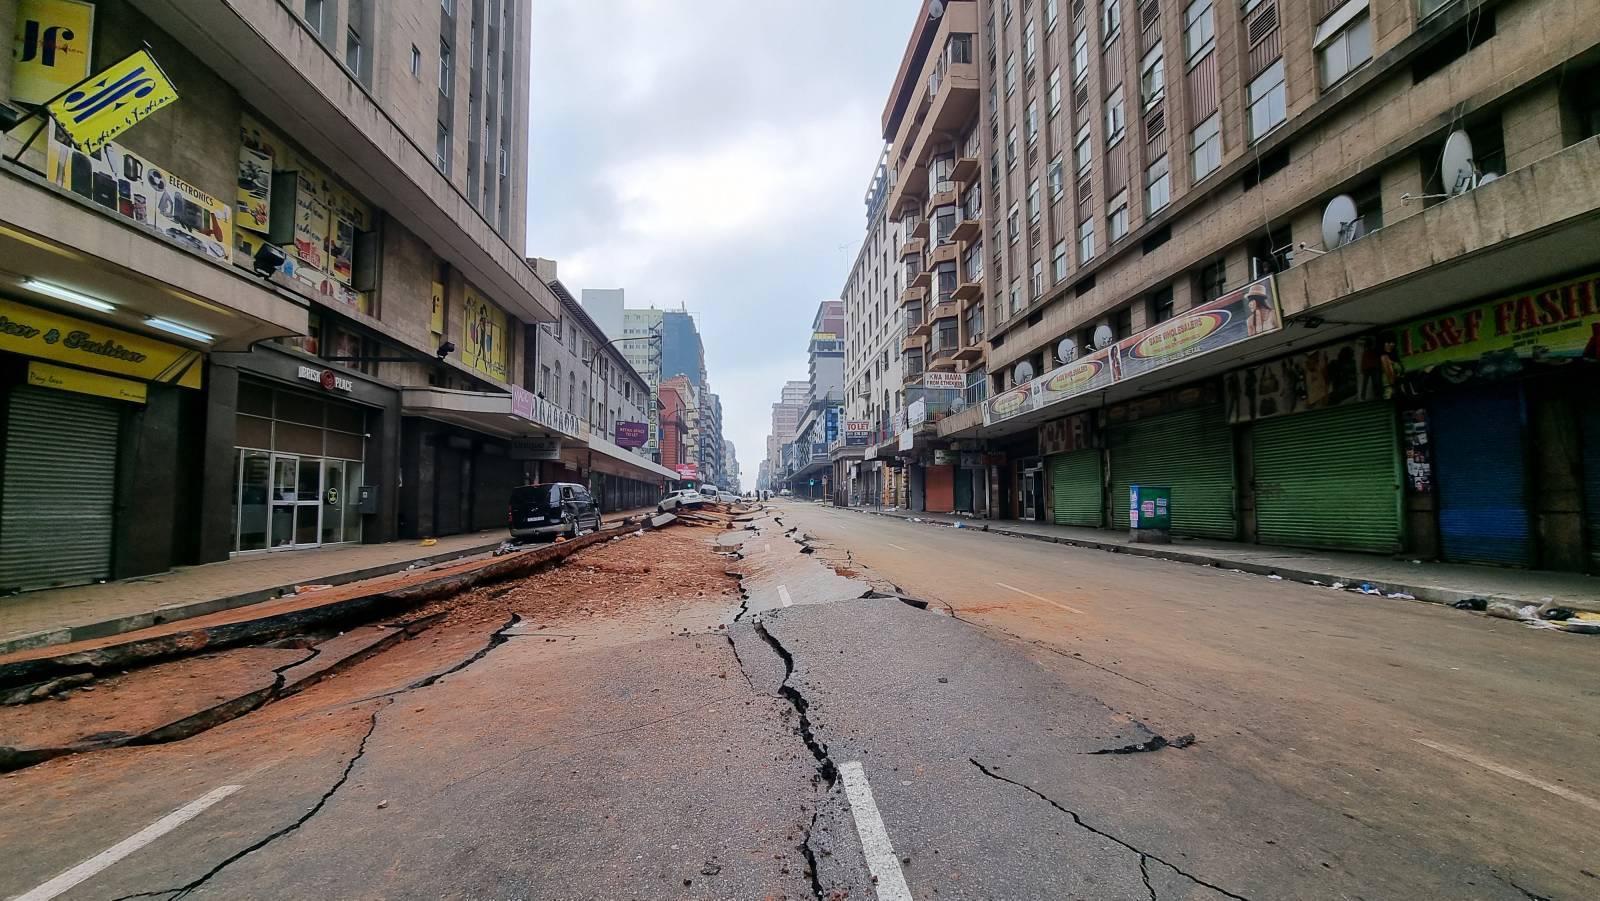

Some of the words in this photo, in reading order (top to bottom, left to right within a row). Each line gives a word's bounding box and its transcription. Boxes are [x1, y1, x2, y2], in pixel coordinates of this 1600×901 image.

[169, 176, 214, 206] ELECTRONICS
[1496, 280, 1600, 336] FASH
[63, 330, 147, 363] Fashion
[335, 376, 353, 392] PLACE
